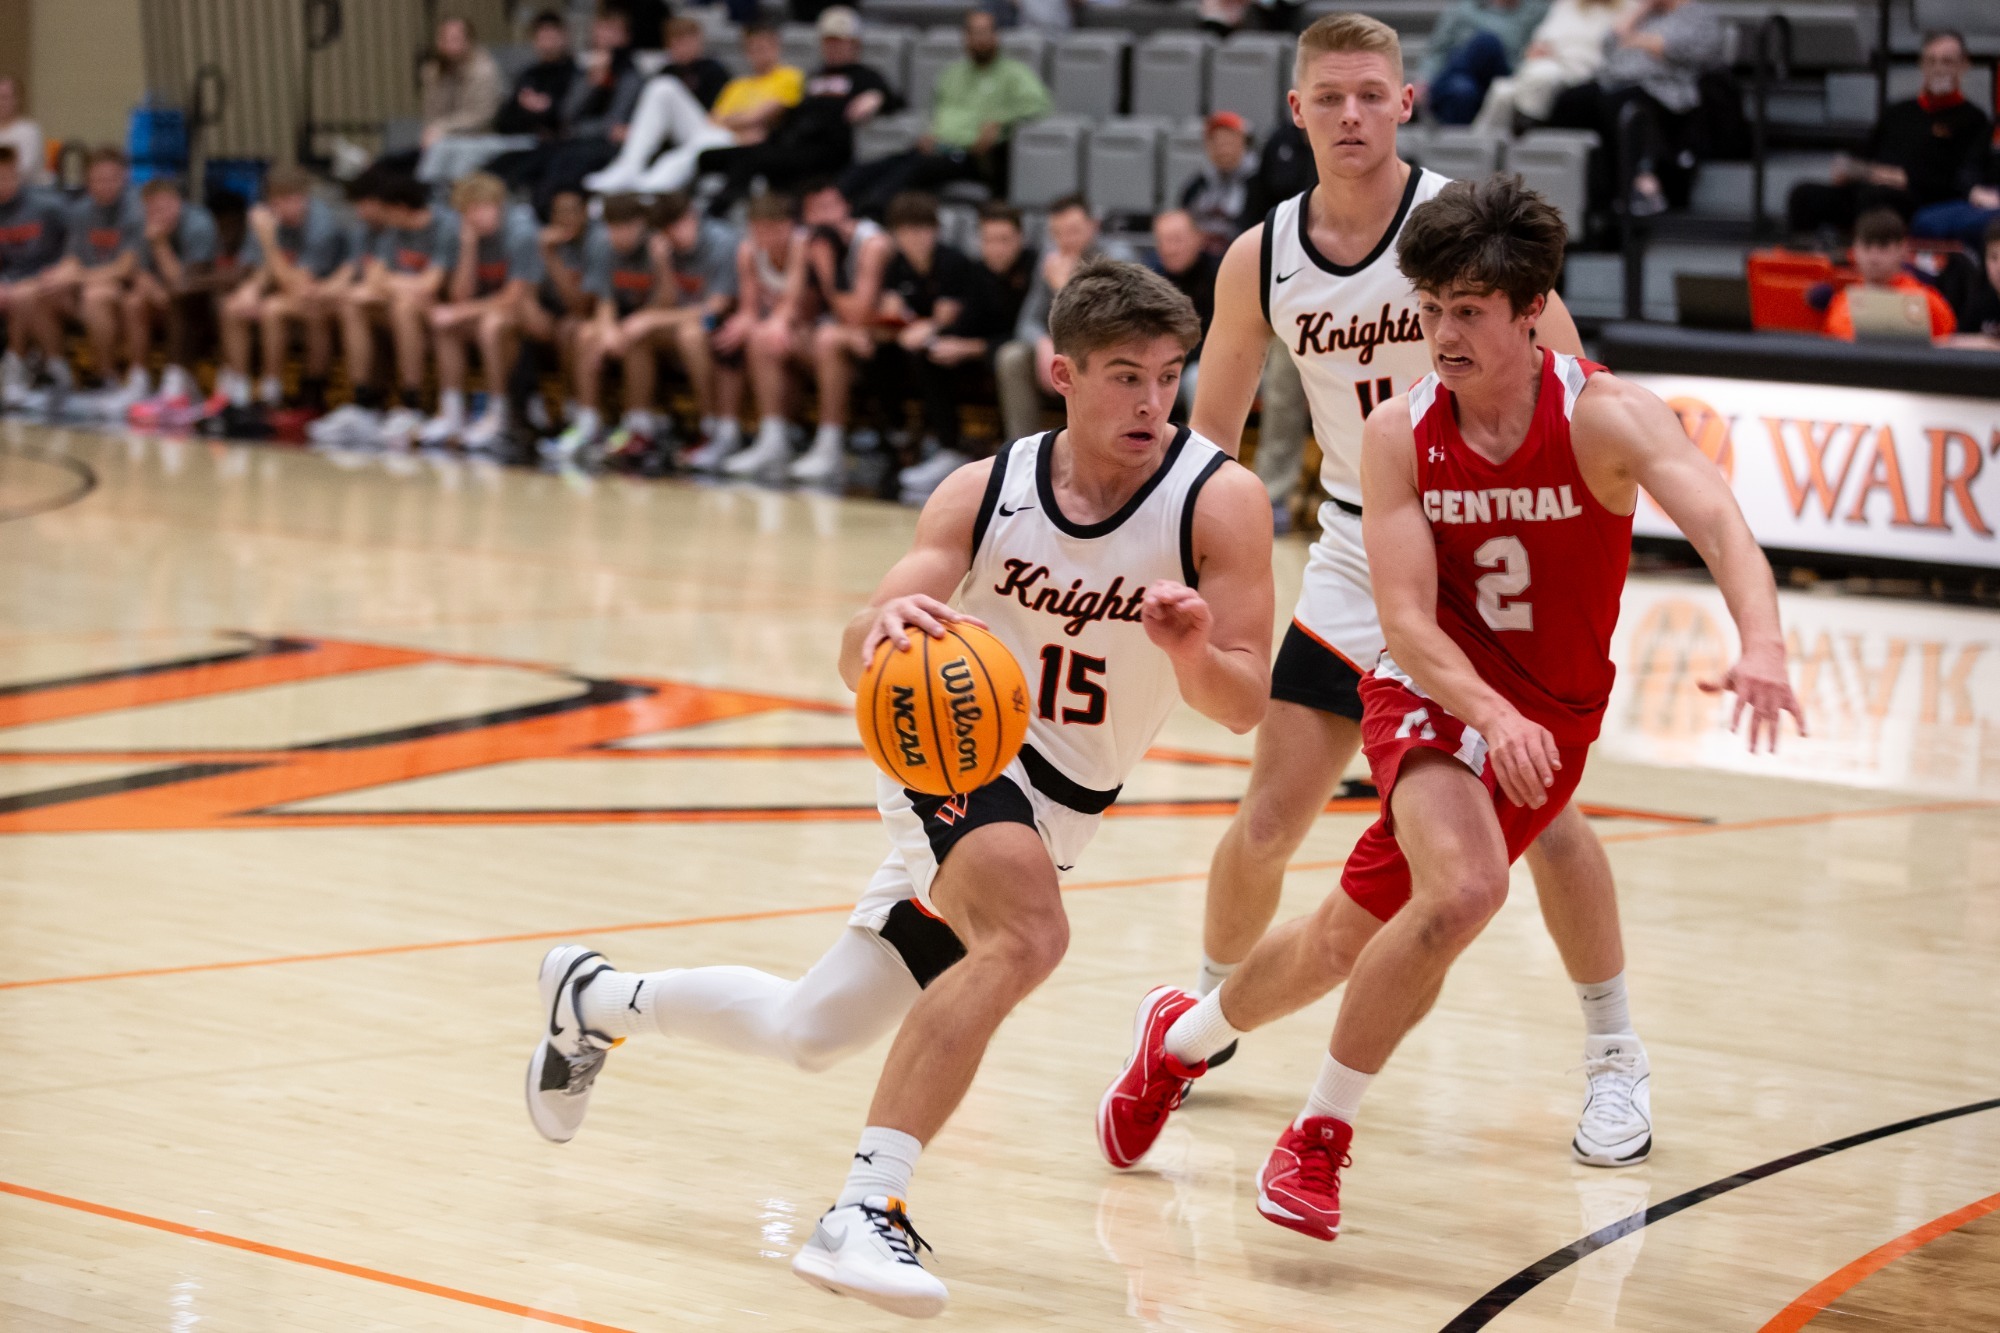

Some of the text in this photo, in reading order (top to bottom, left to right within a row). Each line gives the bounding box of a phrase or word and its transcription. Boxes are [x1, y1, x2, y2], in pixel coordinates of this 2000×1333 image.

[1422, 484, 1582, 524] CENTRAL
[1474, 535, 1533, 632] 2
[891, 684, 928, 768] NCAA
[939, 654, 983, 774] Wilson
[1037, 643, 1107, 726] 15
